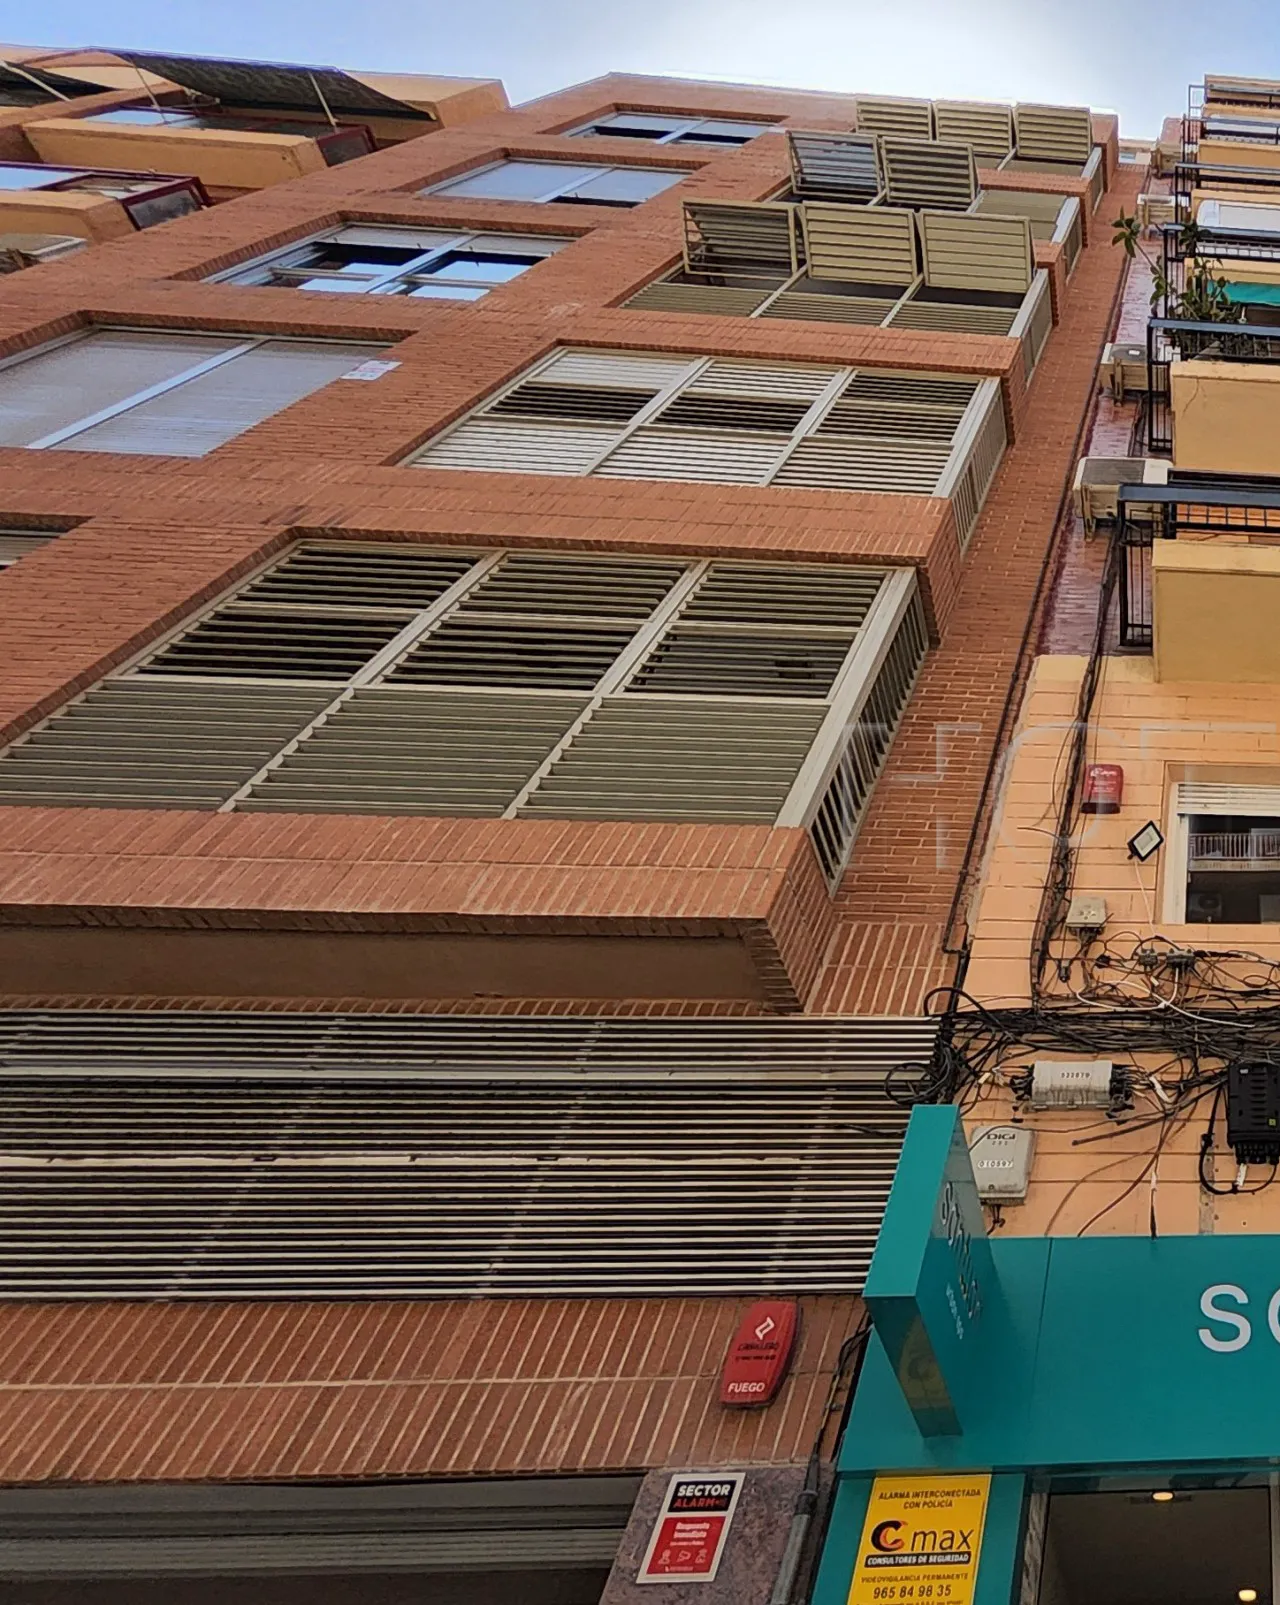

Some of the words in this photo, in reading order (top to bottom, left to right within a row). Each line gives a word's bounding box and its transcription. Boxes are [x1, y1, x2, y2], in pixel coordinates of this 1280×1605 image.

[727, 1382, 766, 1393] FUEGO
[677, 1484, 731, 1497] SECTOR
[878, 1491, 910, 1500] ALARMA
[912, 1489, 981, 1499] INTERCONECTADA
[903, 1501, 920, 1509] CON
[867, 1555, 917, 1566] CONSULTORES
[918, 1555, 927, 1564] DE
[928, 1553, 969, 1564] SEGURIDAD
[922, 1572, 969, 1581] PERMANENTE
[873, 1586, 896, 1600] 965
[899, 1585, 915, 1598] 84
[918, 1585, 933, 1597] 98
[937, 1584, 952, 1597] 35
